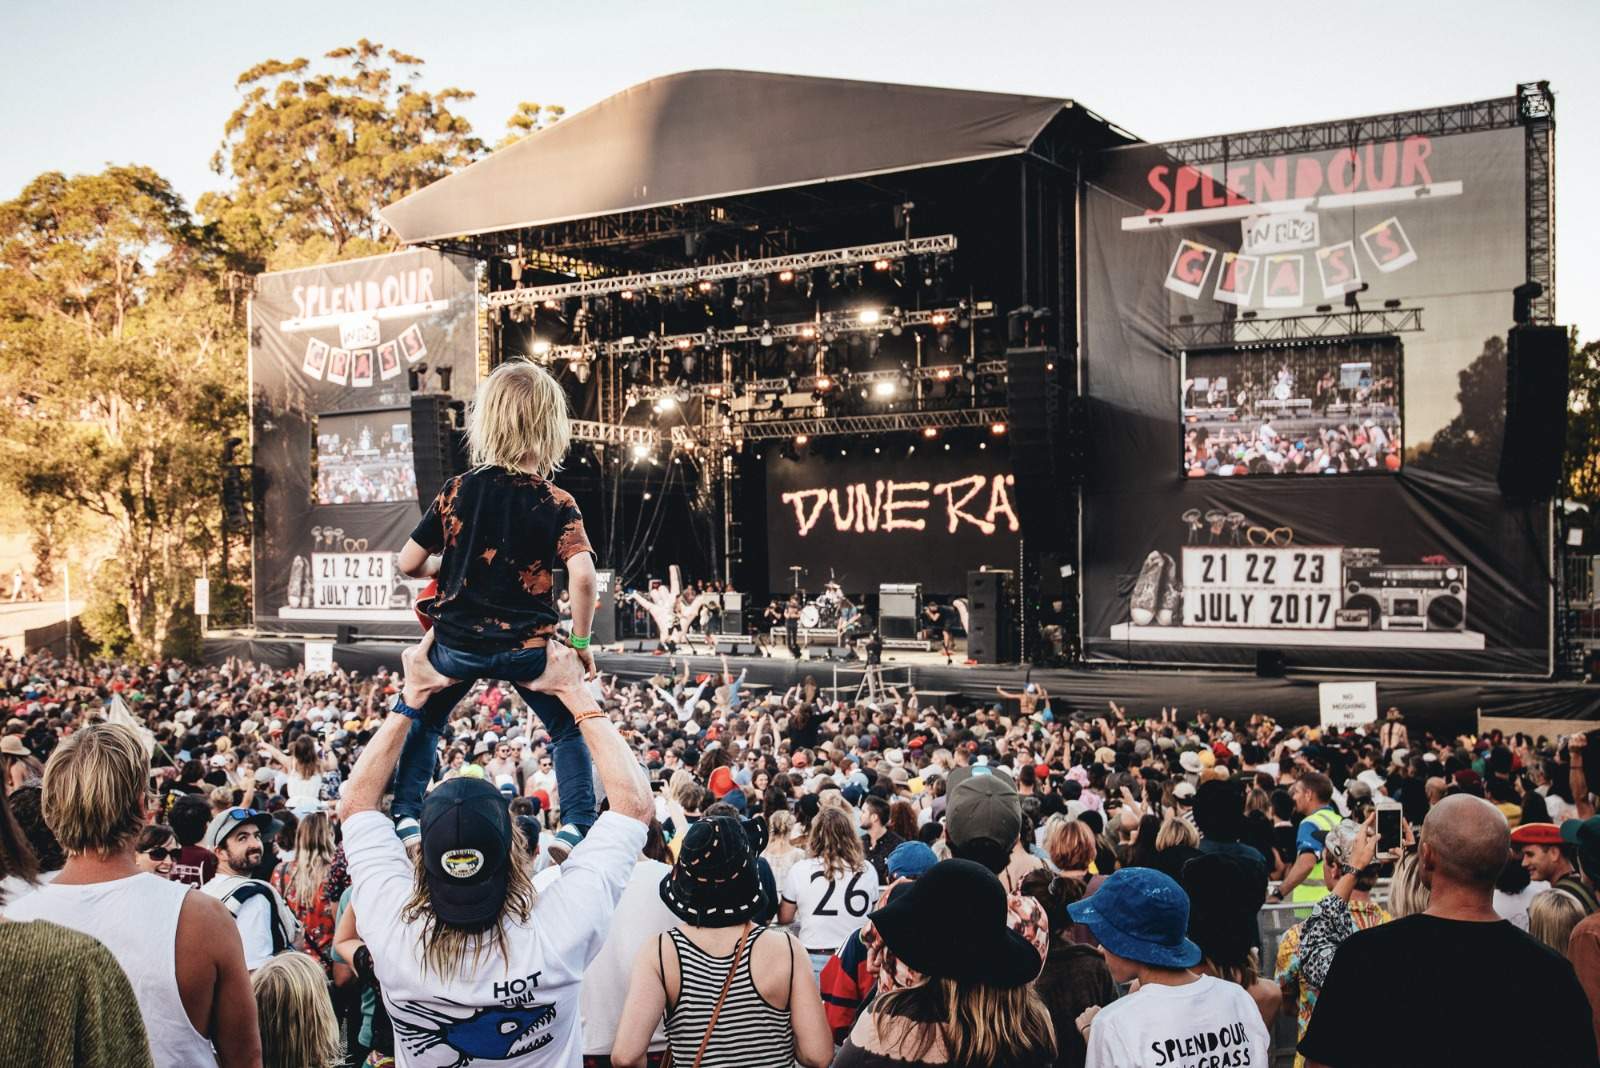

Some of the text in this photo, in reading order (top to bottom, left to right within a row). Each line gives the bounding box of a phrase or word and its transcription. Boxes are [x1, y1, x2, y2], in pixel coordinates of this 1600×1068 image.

[1144, 135, 1433, 216] SPLENDOUR
[1174, 226, 1402, 296] GRASS
[293, 268, 433, 319] SPLENDOUR
[307, 331, 420, 378] GRASS
[781, 474, 1019, 537] DUNE RA
[322, 556, 383, 579] 21 22 23
[1202, 553, 1325, 585] 21 22 23
[320, 584, 387, 606] JULY 2017
[1194, 593, 1332, 624] JULY 2017
[810, 871, 869, 917] 26
[493, 970, 542, 999] HOT
[500, 990, 536, 1006] TUNA
[1151, 1021, 1249, 1067] SPLENDOUR
[1199, 1047, 1251, 1068] GRASS
